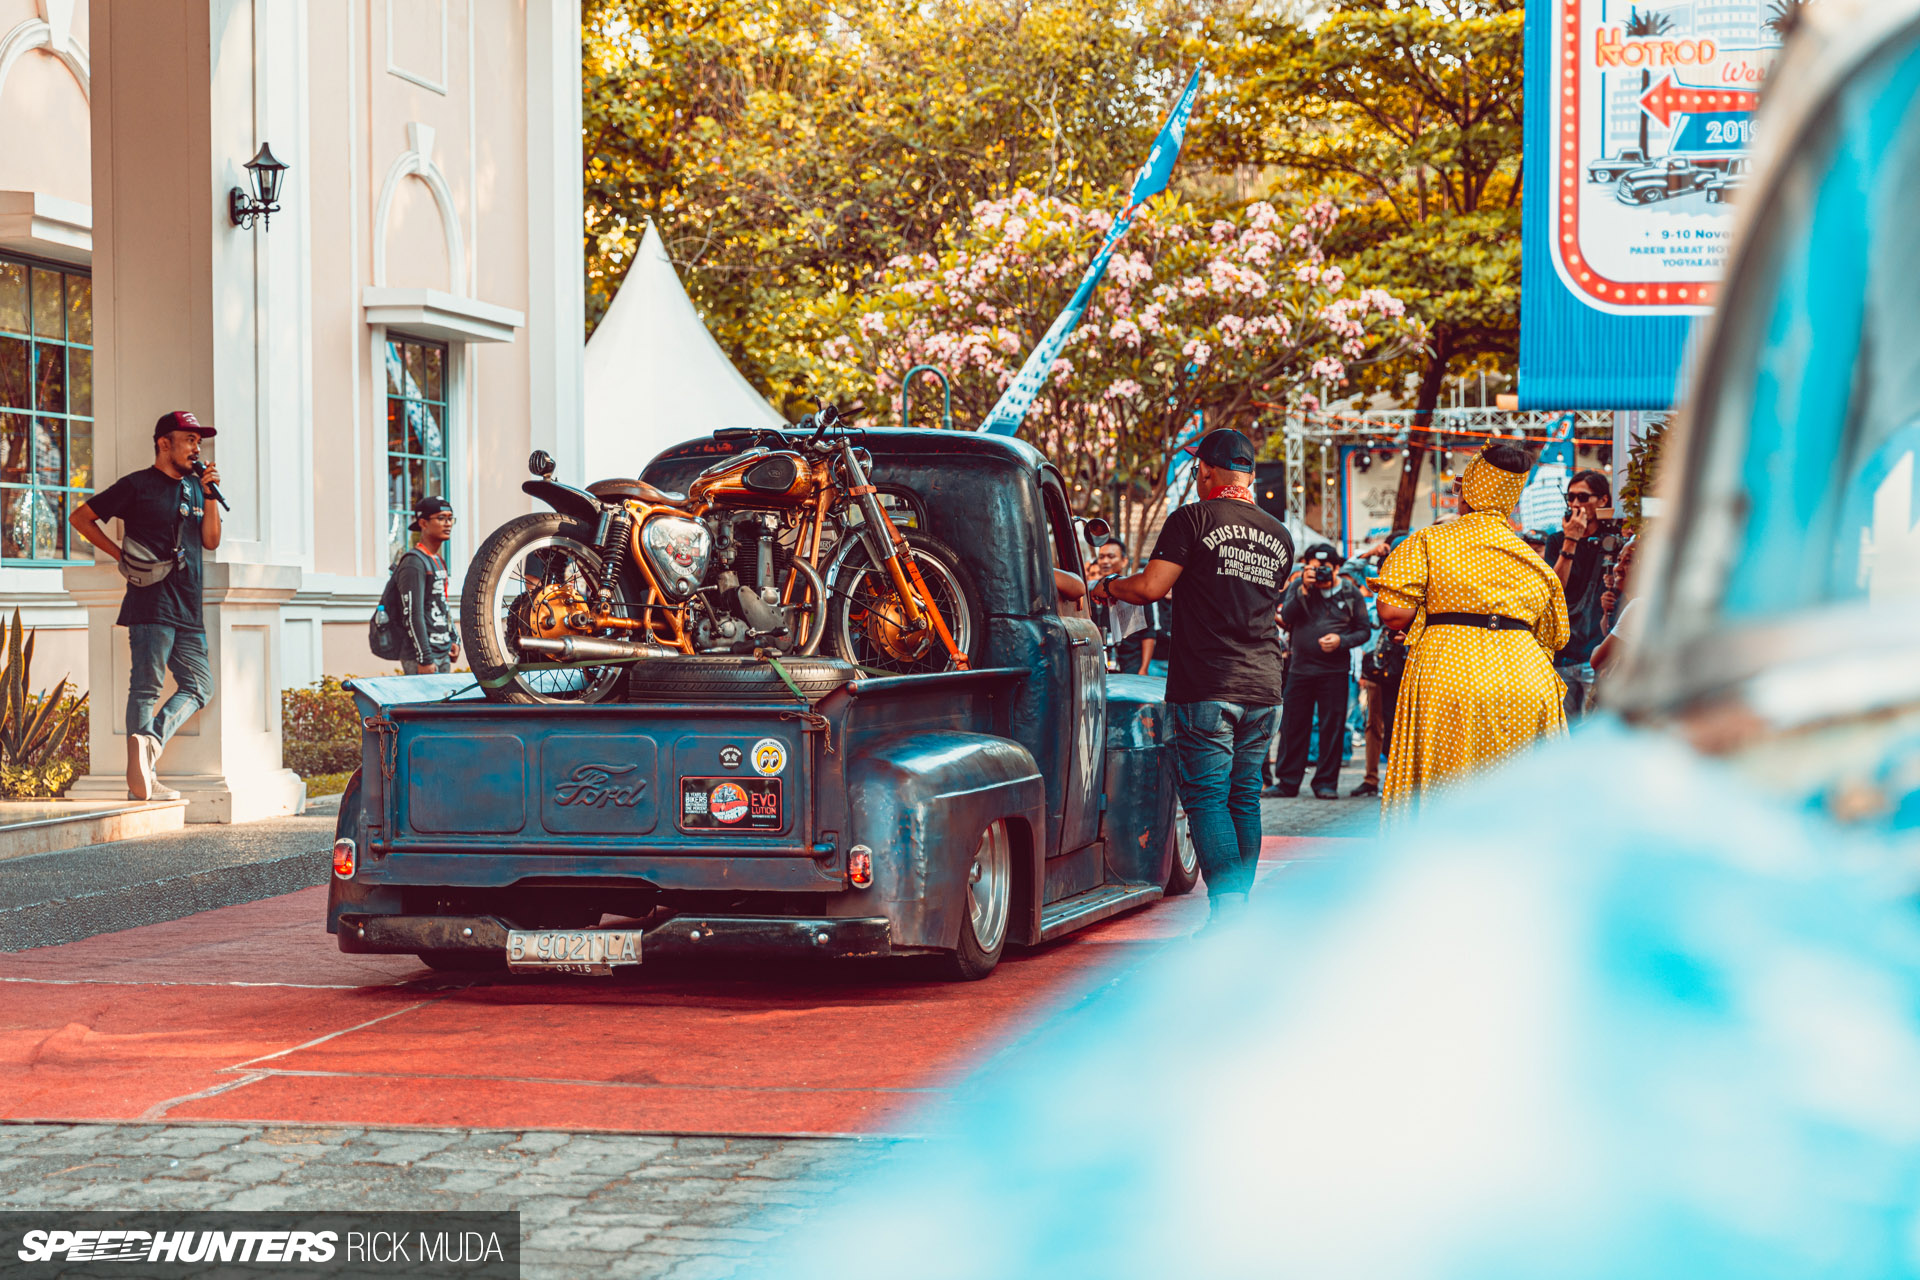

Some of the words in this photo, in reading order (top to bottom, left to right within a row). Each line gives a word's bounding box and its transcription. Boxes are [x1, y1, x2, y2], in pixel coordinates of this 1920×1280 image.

[1722, 60, 1773, 83] Wee
[1661, 229, 1691, 240] 9-10
[1695, 229, 1733, 240] Nove
[1669, 246, 1704, 254] BARAT
[1202, 525, 1232, 550] DEUS
[1233, 525, 1248, 539] EX
[1249, 528, 1288, 567] MACHINA
[1218, 545, 1280, 572] MOTORCYCLES
[1224, 559, 1244, 571] PARTS
[1251, 566, 1274, 579] SERVICE
[1224, 568, 1238, 576] BATU
[553, 763, 648, 809] Ford
[752, 794, 776, 806] EVO
[510, 933, 527, 961] B
[537, 932, 596, 961] 9021
[603, 931, 637, 961] LA
